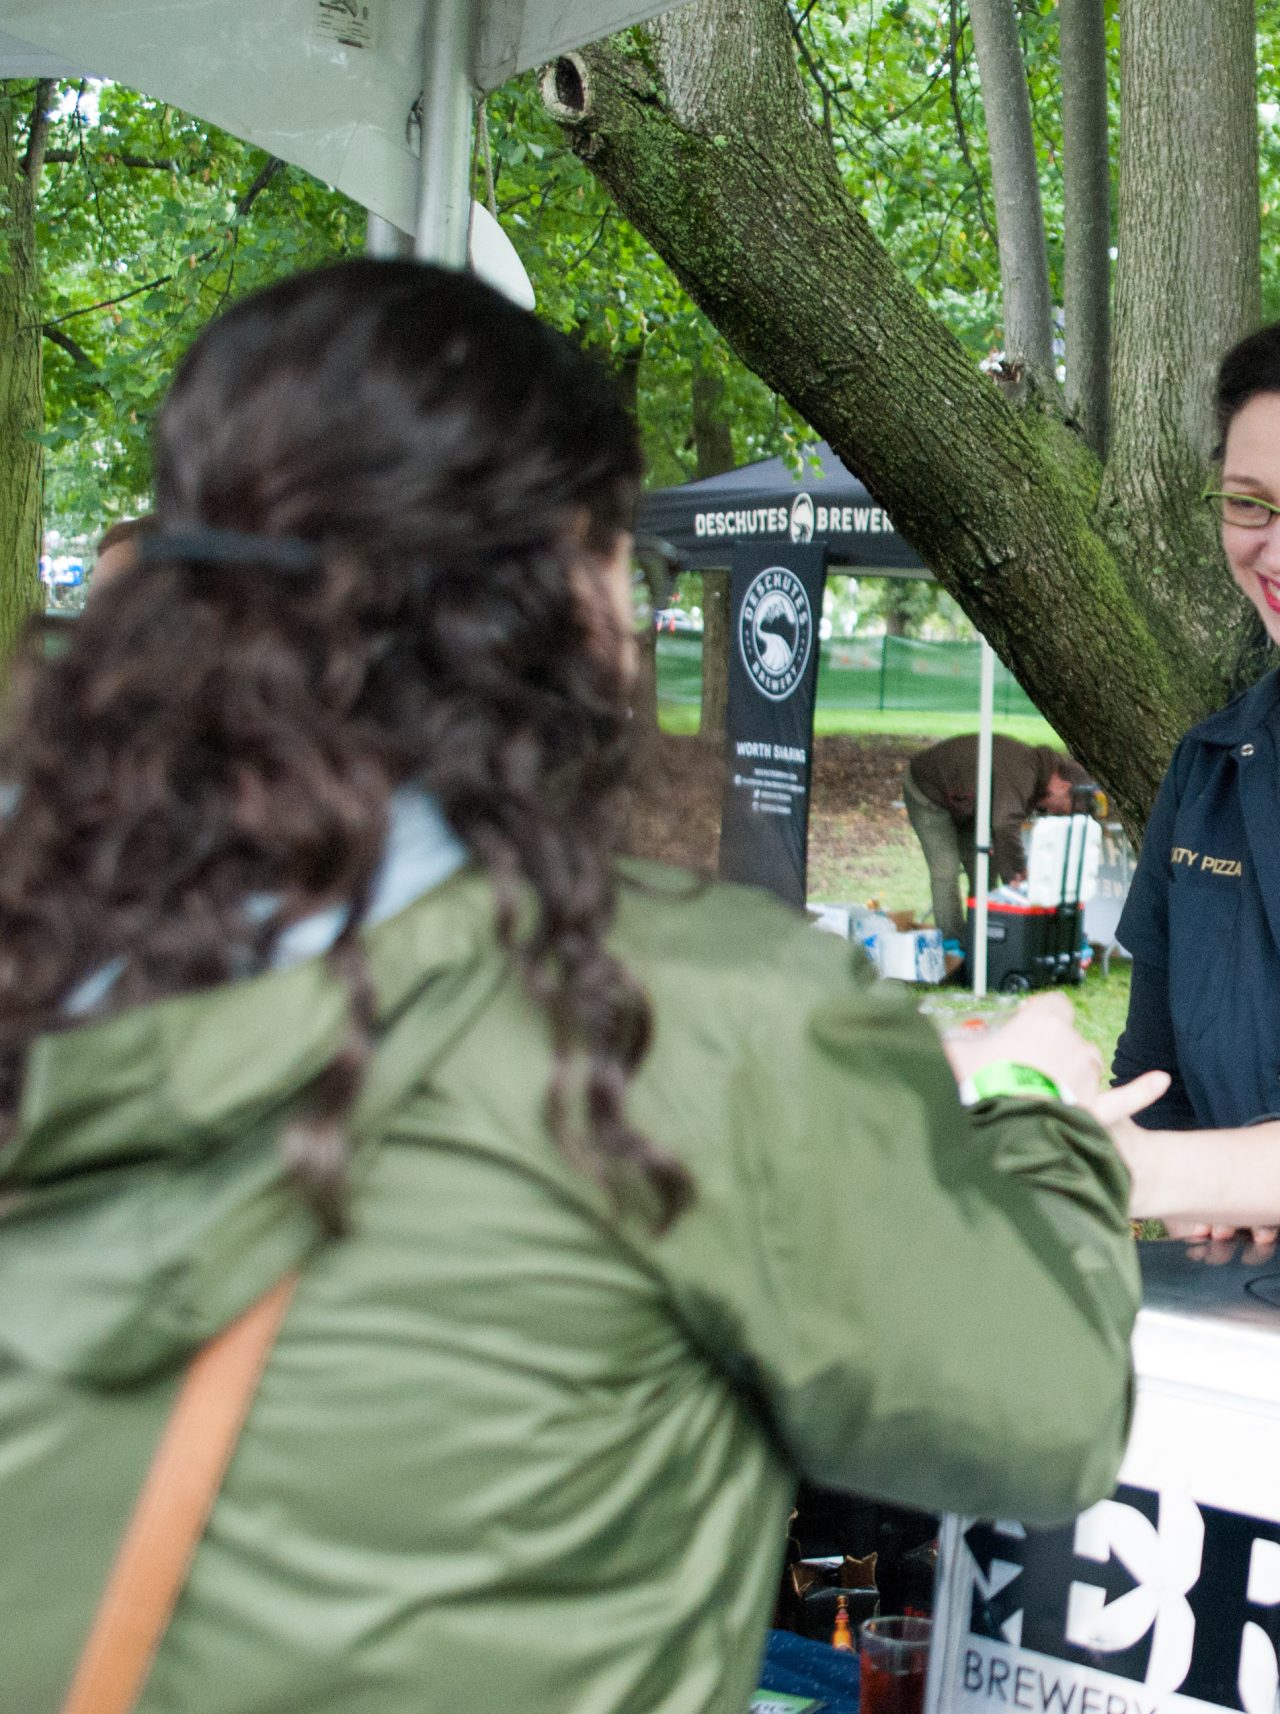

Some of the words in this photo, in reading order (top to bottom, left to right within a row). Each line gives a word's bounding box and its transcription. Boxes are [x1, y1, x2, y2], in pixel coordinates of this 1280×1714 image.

[695, 507, 788, 536] DESCHUTES
[744, 573, 808, 626] DESCHUTES
[752, 661, 797, 692] BREWERY
[736, 741, 772, 758] WORTH
[1201, 855, 1242, 877] PIZZA
[963, 1650, 1157, 1714] BREWE
